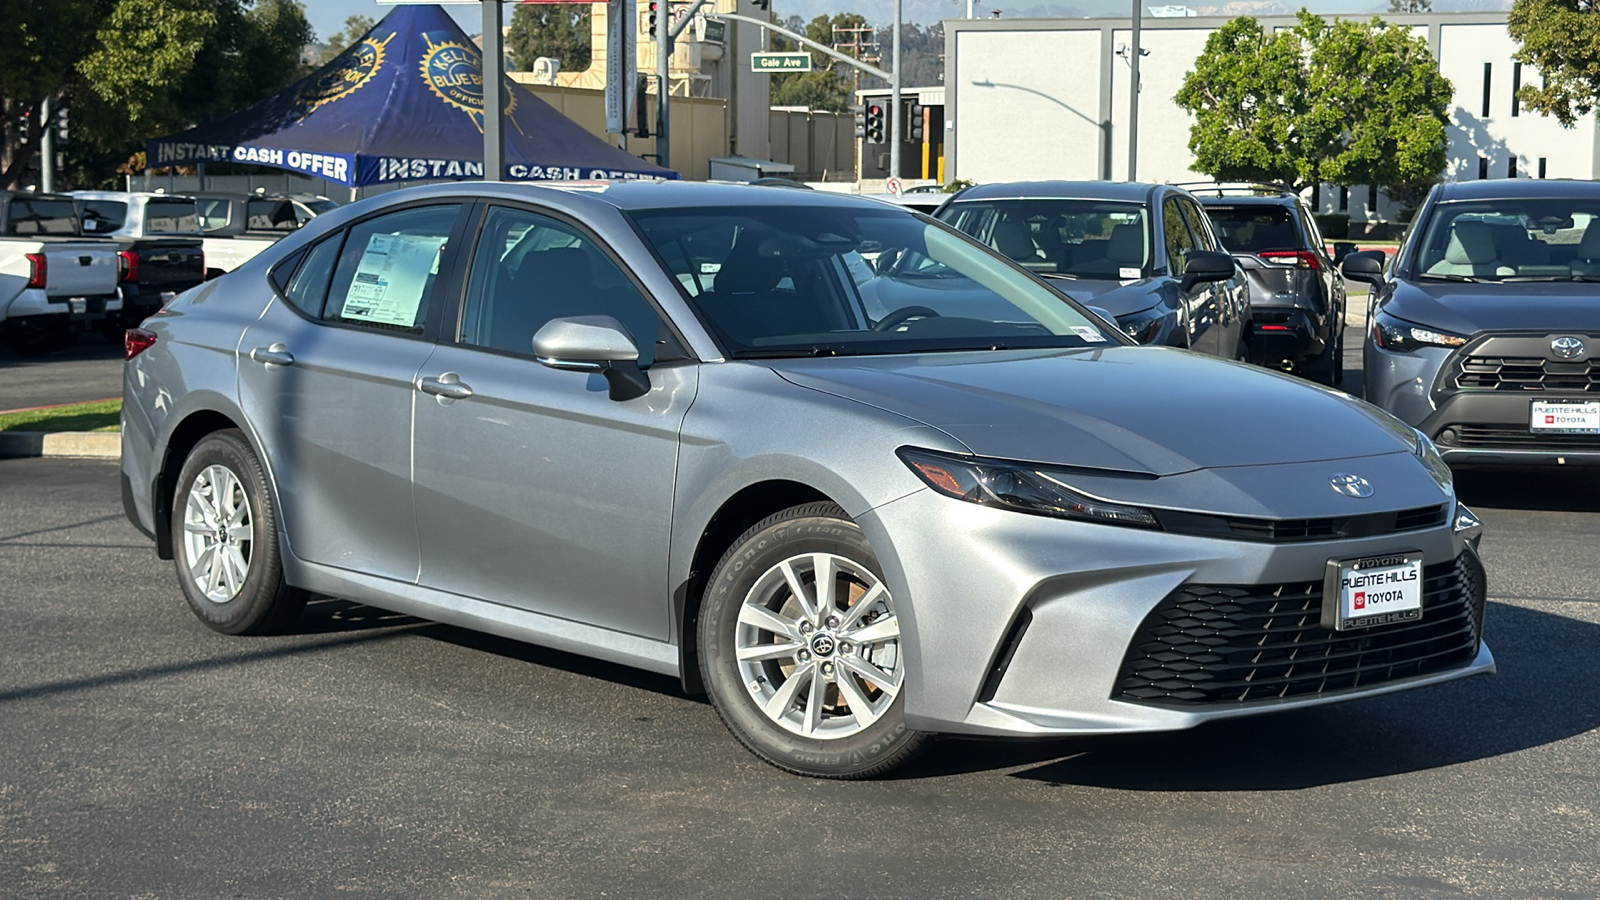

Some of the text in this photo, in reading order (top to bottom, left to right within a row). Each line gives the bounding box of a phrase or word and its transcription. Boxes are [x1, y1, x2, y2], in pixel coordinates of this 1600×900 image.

[433, 50, 482, 70] KELLE
[761, 57, 801, 67] Gale Ave
[433, 73, 469, 88] BLUE
[158, 142, 348, 182] INSTANT CASH OFFER
[379, 158, 484, 181] INSTAN
[1361, 557, 1404, 568] TOYOTA
[1341, 570, 1417, 590] PUENTE HILLS
[1367, 590, 1404, 605] TOYOTA
[1344, 611, 1418, 628] PUENTE HILLS
